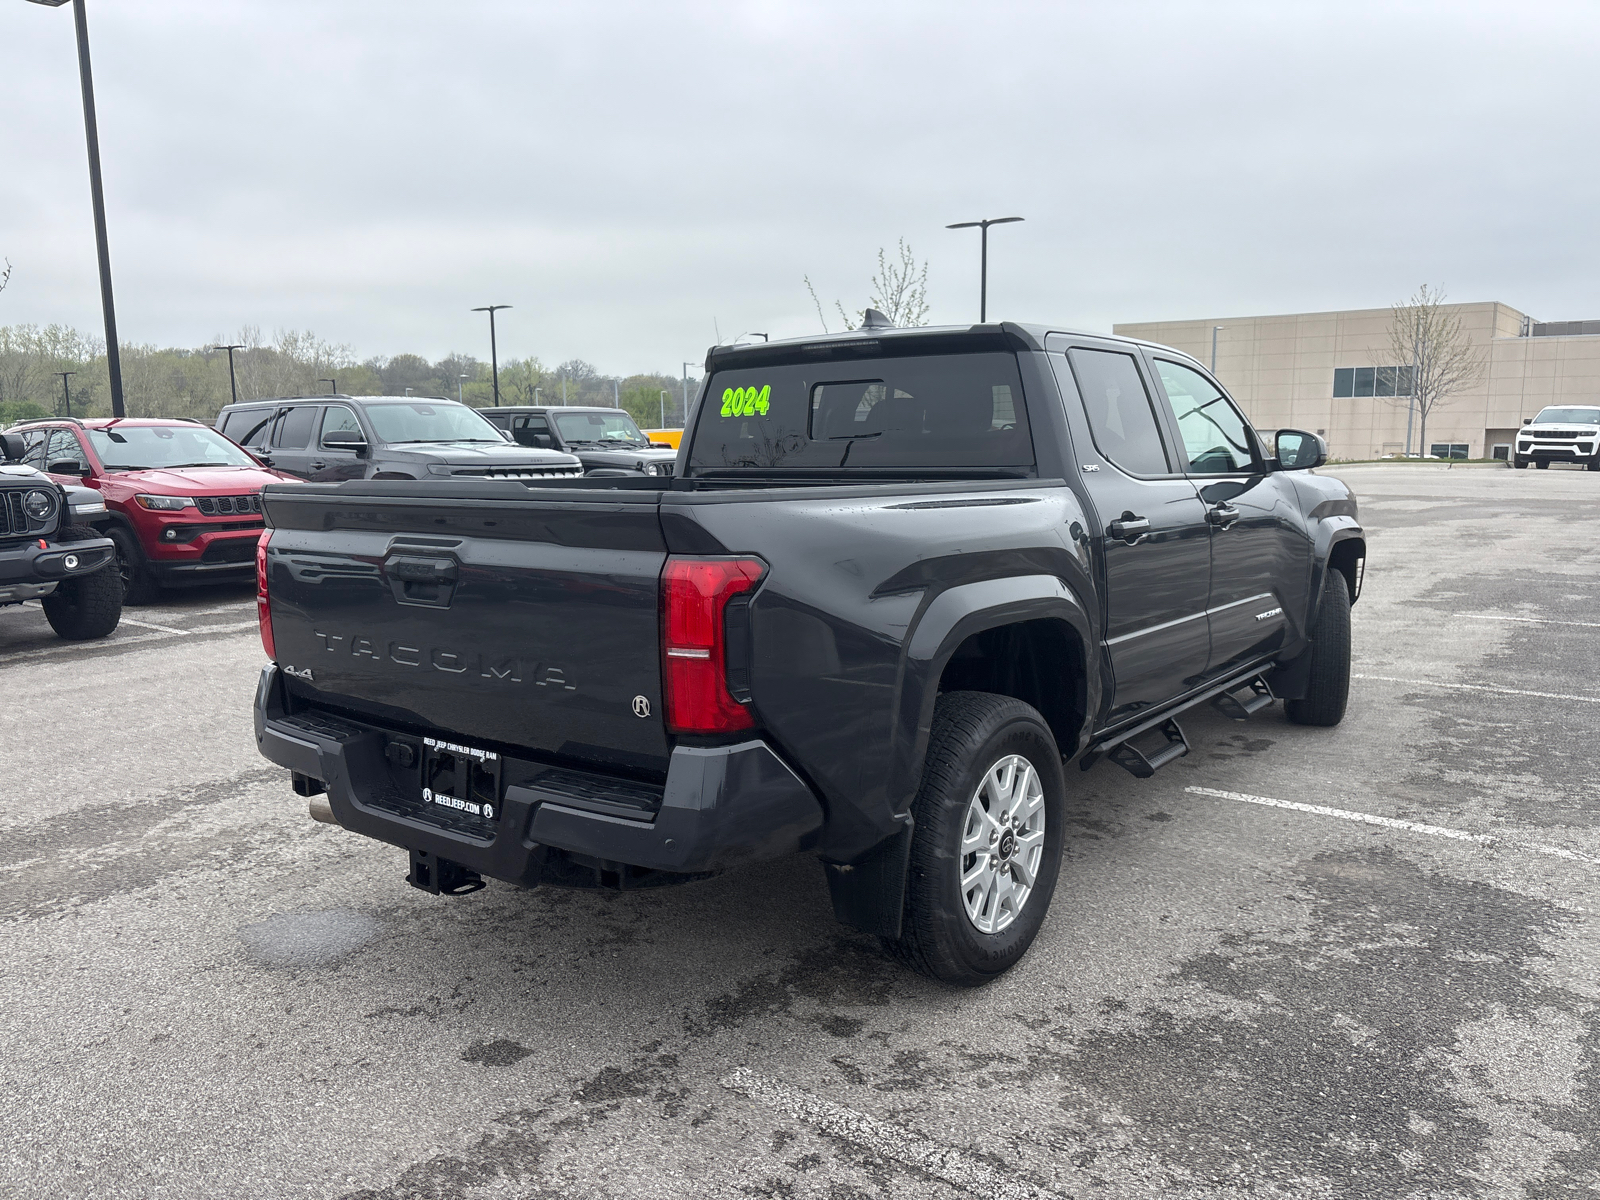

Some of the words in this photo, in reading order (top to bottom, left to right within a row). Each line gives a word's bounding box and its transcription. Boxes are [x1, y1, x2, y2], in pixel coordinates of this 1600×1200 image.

[720, 384, 771, 417] 2024
[313, 628, 577, 691] TACOMA
[423, 737, 436, 747] REED
[436, 740, 447, 749] JEEP
[447, 742, 470, 755] CHRYSLER
[470, 747, 486, 758] DODGE
[485, 751, 497, 760] RAM
[434, 793, 480, 815] REEDJEEP.COM
